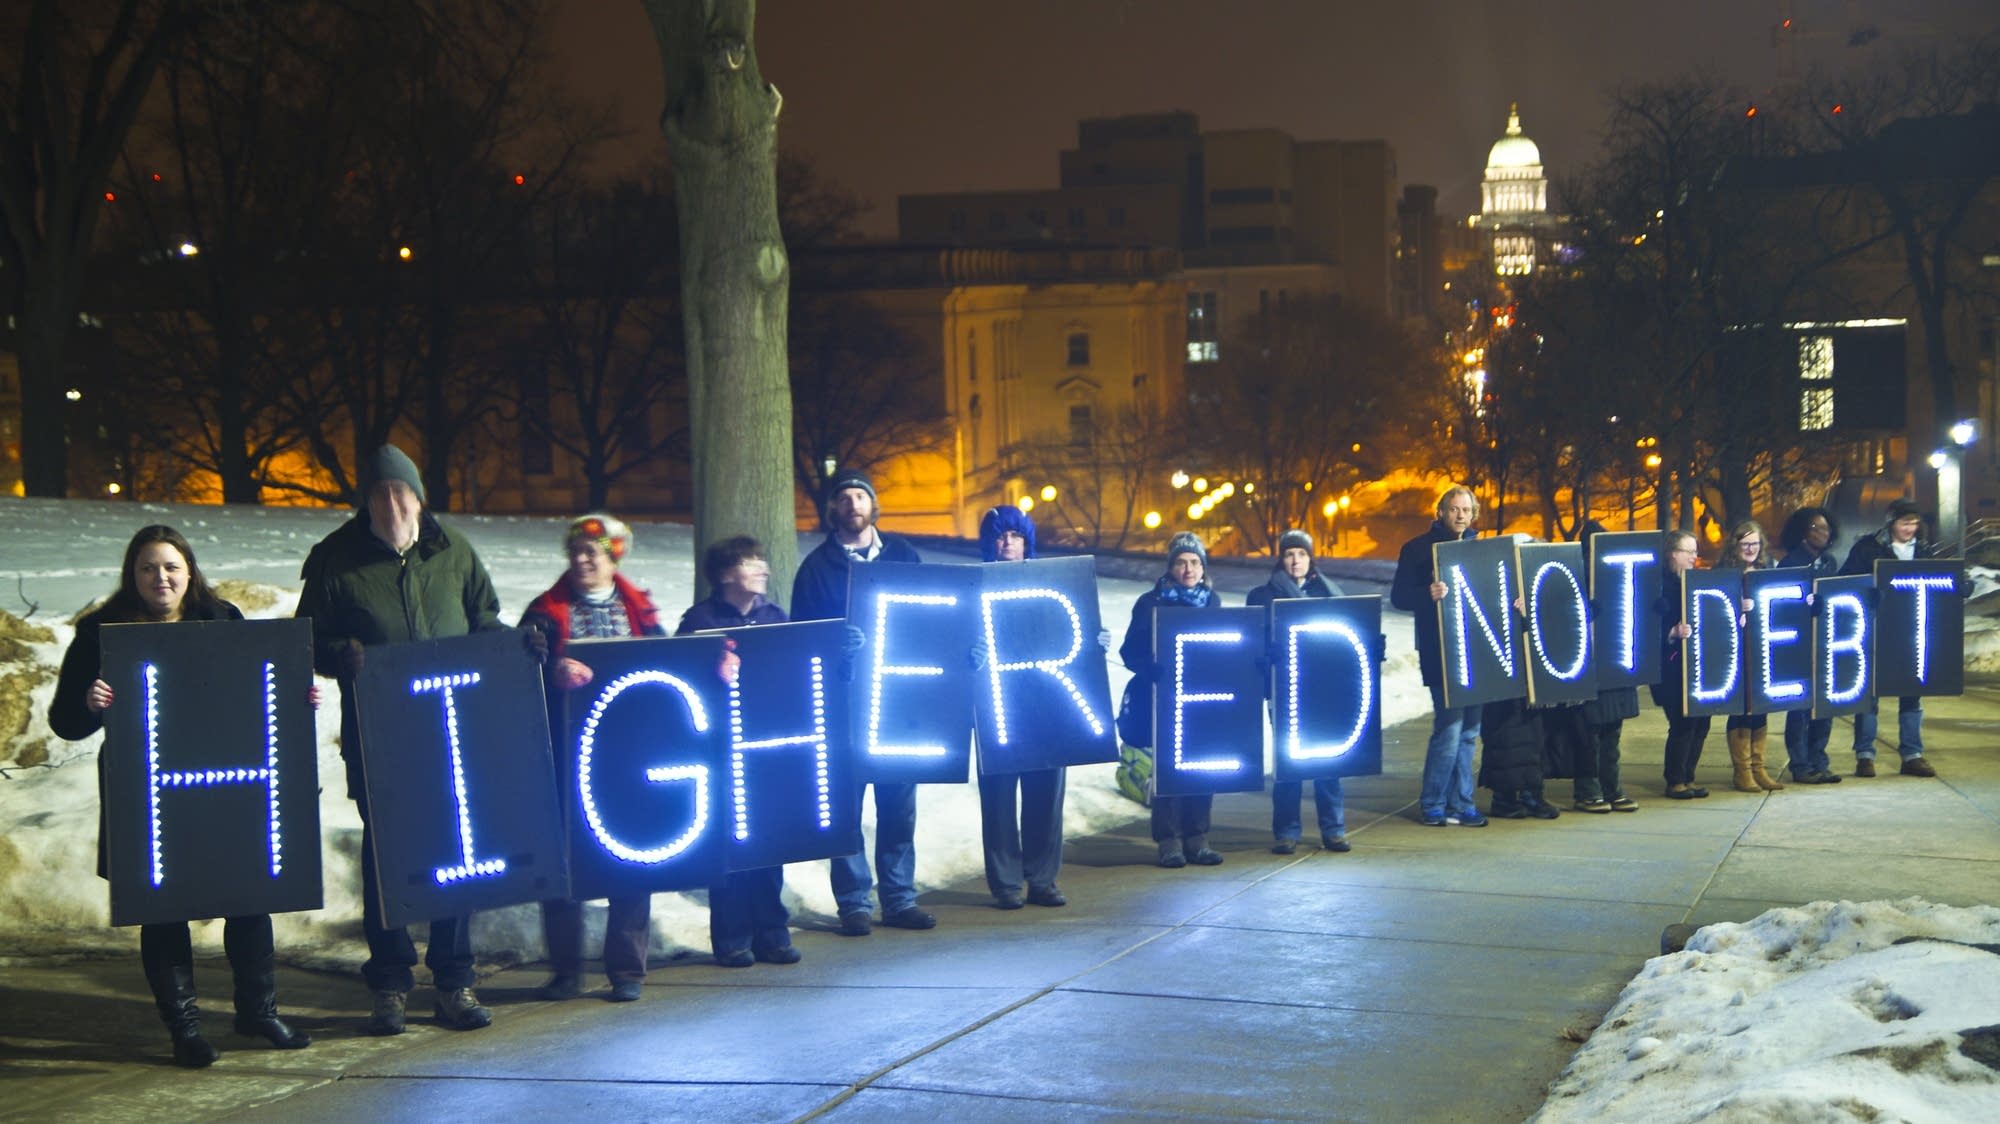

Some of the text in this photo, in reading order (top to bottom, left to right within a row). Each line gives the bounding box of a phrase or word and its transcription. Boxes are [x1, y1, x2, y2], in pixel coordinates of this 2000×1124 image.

[143, 552, 1955, 887] HIGHER ED NOT DEBT
